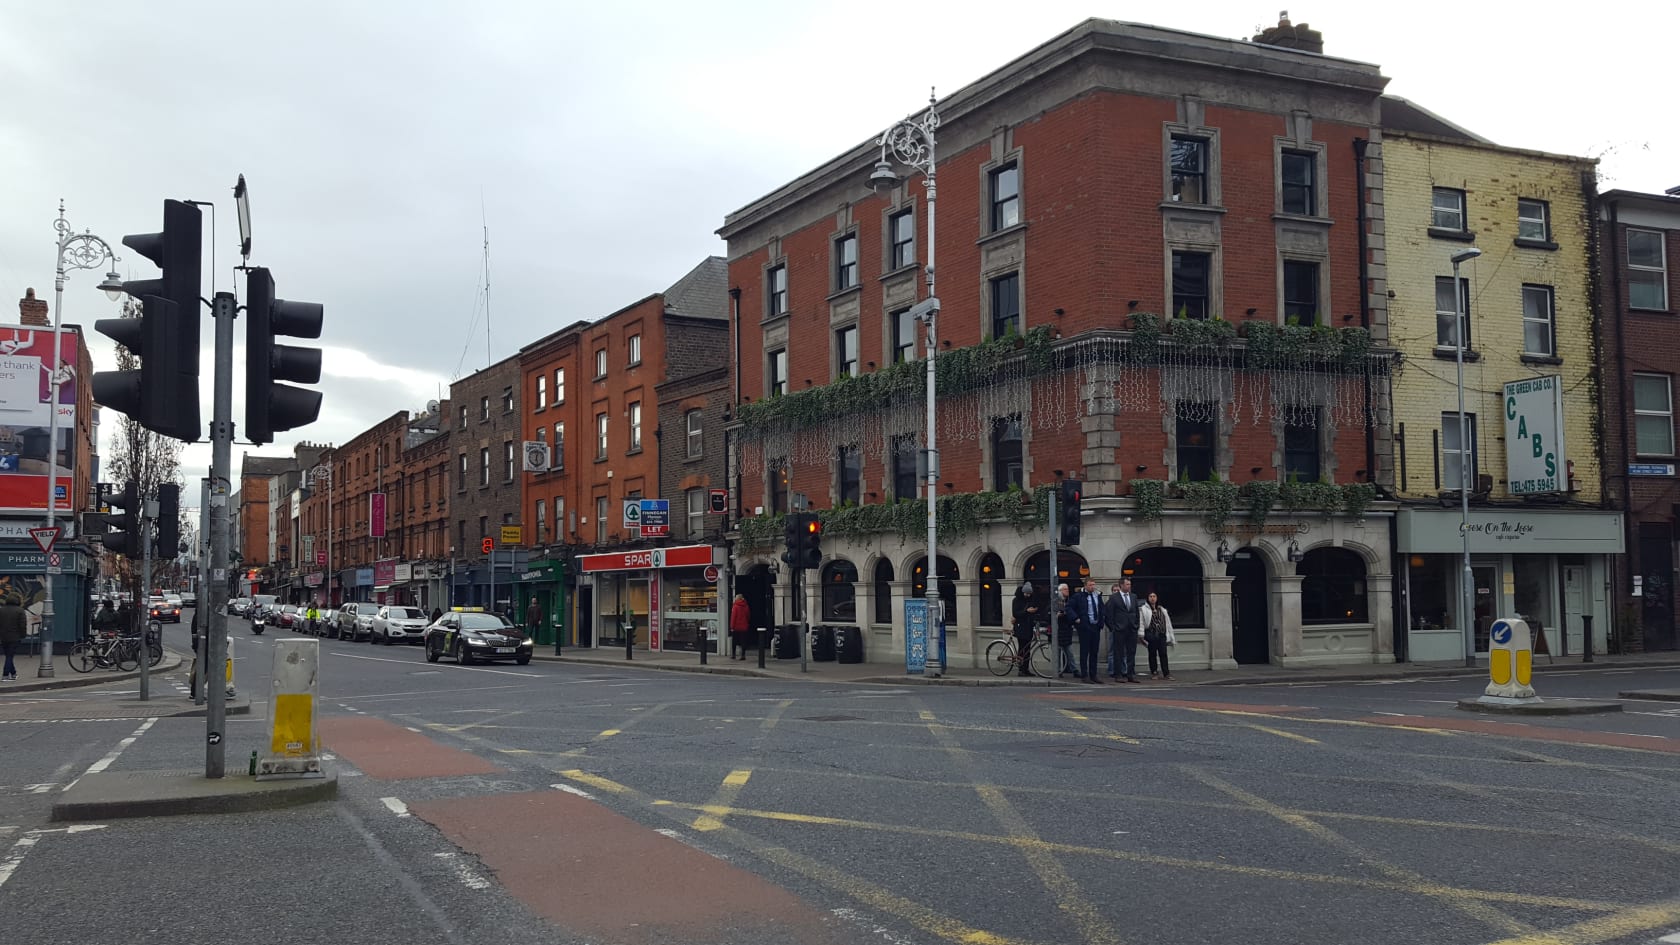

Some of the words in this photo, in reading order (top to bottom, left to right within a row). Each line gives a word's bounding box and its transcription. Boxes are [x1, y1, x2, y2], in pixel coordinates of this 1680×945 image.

[4, 361, 35, 370] thank
[1506, 385, 1515, 395] THE
[1516, 382, 1532, 394] GREEN
[1532, 380, 1542, 391] CAB
[57, 408, 73, 416] sky
[624, 553, 652, 567] SPAR
